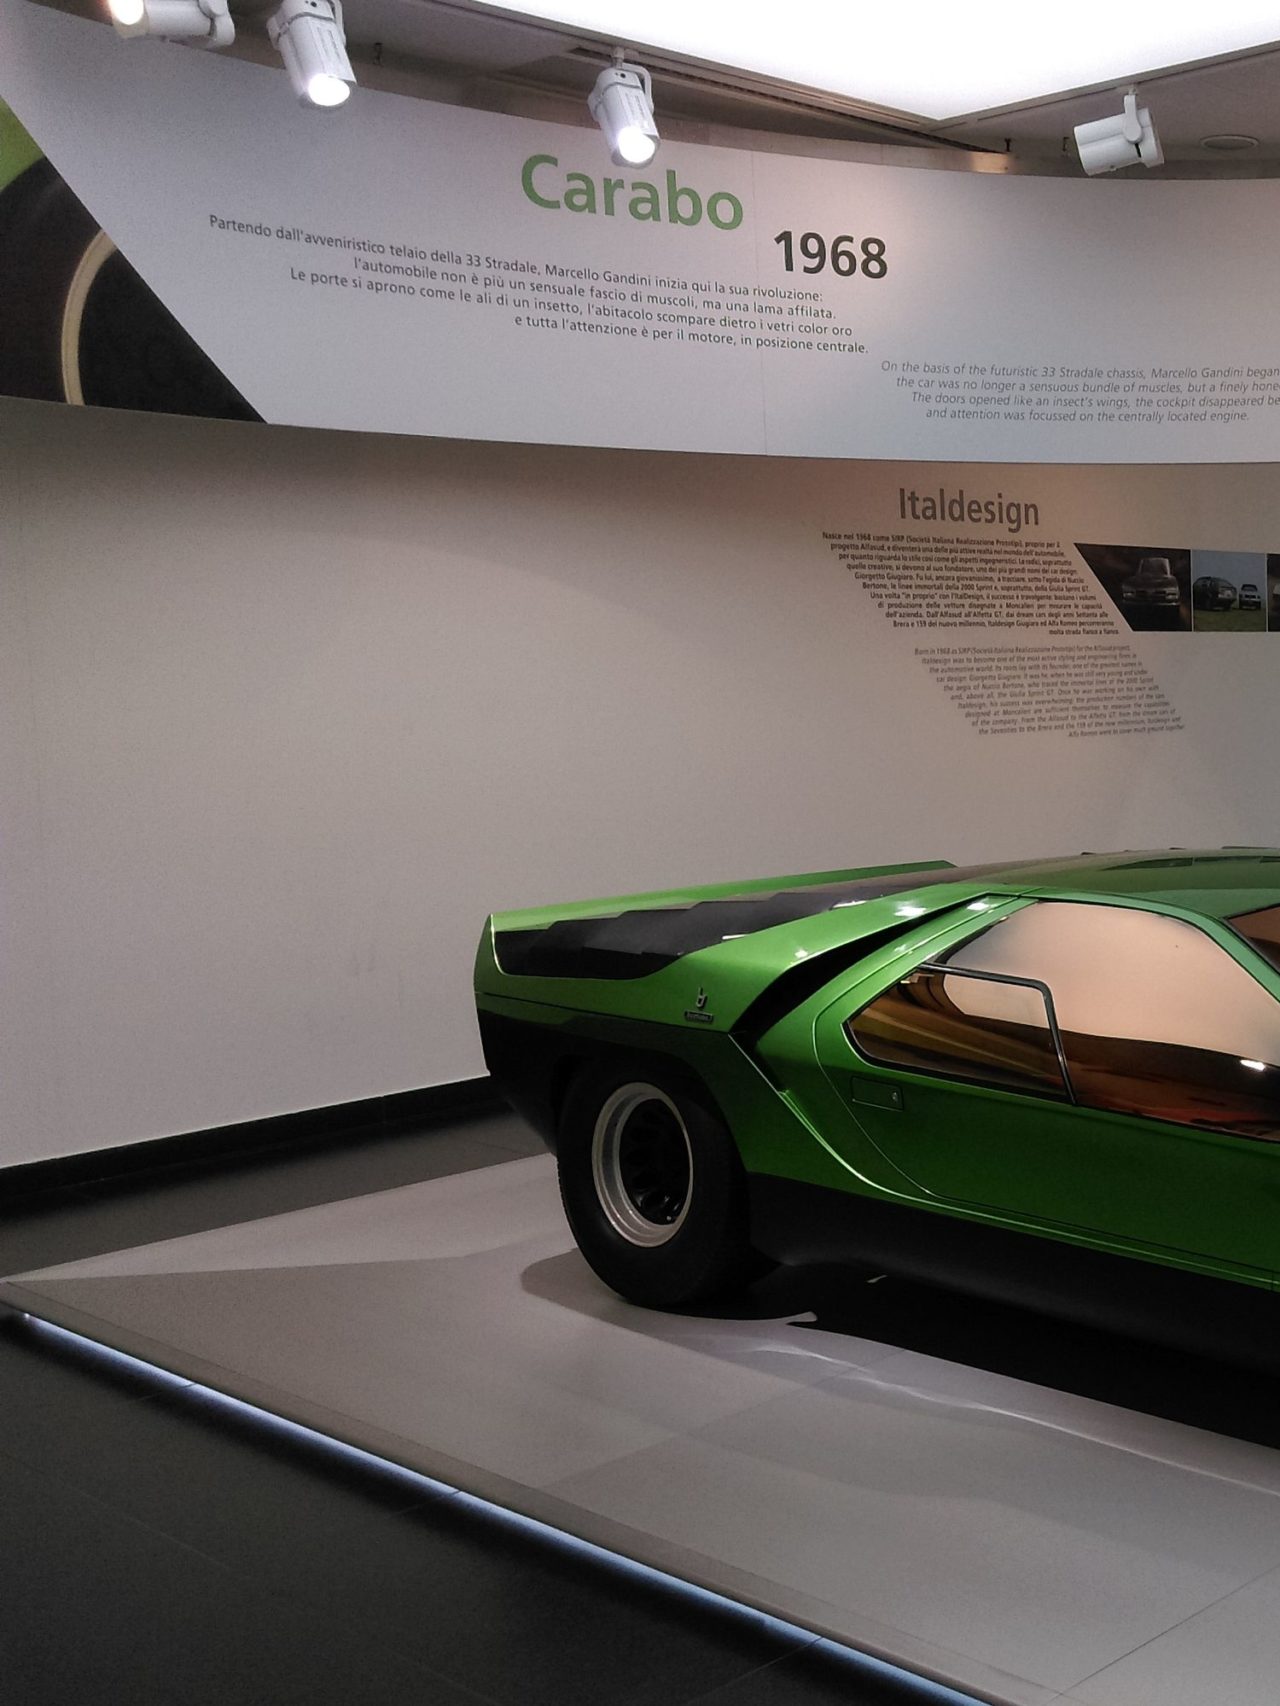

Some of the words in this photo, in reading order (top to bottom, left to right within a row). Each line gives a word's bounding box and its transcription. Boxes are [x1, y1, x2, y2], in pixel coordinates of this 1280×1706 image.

[521, 154, 744, 230] Carabo
[208, 213, 272, 237] Partendo
[274, 225, 385, 255] dall'avveniristico
[389, 244, 427, 261] telaio
[430, 249, 462, 265] della
[465, 253, 481, 267] 33
[484, 255, 540, 276] Stradale,
[544, 262, 600, 281] Marcello
[602, 269, 651, 287] Gandini
[655, 276, 687, 290] inizia
[691, 281, 711, 295] qui
[714, 281, 725, 294] la
[728, 284, 749, 295] sua
[752, 285, 822, 302] rivoluzione:
[774, 231, 888, 279] 1968
[290, 267, 306, 281] Le
[310, 273, 348, 288] porte
[351, 278, 362, 290] si
[366, 281, 415, 296] aprono
[419, 287, 455, 300] come
[459, 289, 471, 302] le
[476, 291, 491, 304] ali
[495, 293, 508, 306] di
[512, 297, 529, 309] un
[534, 298, 582, 316] insetto,
[587, 303, 653, 321] l'abitacolo
[656, 312, 715, 329] scompare
[719, 315, 756, 329] dietro
[759, 319, 763, 330] i
[766, 321, 794, 333] vetri
[797, 323, 827, 336] color
[831, 327, 852, 338] oro
[354, 256, 437, 280] l'automobile
[440, 271, 466, 284] non
[471, 273, 478, 286] è
[483, 276, 504, 291] più
[508, 280, 525, 291] un
[529, 283, 584, 298] sensuale
[589, 286, 626, 301] fascio
[630, 290, 642, 303] di
[646, 294, 697, 310] muscoli,
[702, 299, 721, 310] ma
[725, 301, 748, 313] una
[753, 301, 783, 316] lama
[787, 305, 835, 320] affilata.
[514, 316, 522, 326] e
[526, 316, 558, 330] tutta
[561, 318, 637, 337] l'attenzione
[641, 325, 648, 338] è
[652, 329, 672, 343] per
[676, 329, 684, 341] il
[687, 332, 736, 347] motore,
[740, 335, 752, 347] in
[755, 338, 813, 351] posizione
[816, 341, 868, 355] centrale.
[881, 359, 897, 371] On
[901, 361, 919, 372] the
[923, 362, 949, 374] basis
[953, 363, 964, 375] of
[968, 364, 986, 375] the
[990, 364, 1036, 376] futuristic
[1042, 365, 1055, 377] 33
[1059, 366, 1103, 378] Stradale
[1151, 367, 1197, 378] Marcello
[1201, 367, 1242, 378] Gandini
[1246, 366, 1279, 380] began
[896, 376, 914, 387] the
[917, 379, 934, 388] car
[937, 380, 960, 389] was
[963, 381, 977, 390] no
[980, 379, 1015, 394] longer
[1019, 383, 1025, 392] a
[1029, 384, 1078, 392] sensuous
[1082, 381, 1120, 392] bundle
[1123, 382, 1134, 393] of
[1187, 382, 1205, 393] but
[1209, 384, 1215, 393] a
[1219, 380, 1248, 395] finely
[912, 391, 931, 403] The
[934, 392, 965, 404] doors
[968, 395, 1010, 409] opened
[1013, 395, 1032, 406] like
[1035, 398, 1049, 406] an
[1052, 396, 1093, 407] insect's
[1134, 397, 1153, 408] the
[1156, 397, 1195, 411] cockpit
[1198, 394, 1264, 410] disappeared
[926, 407, 946, 418] and
[950, 408, 1000, 419] attention
[1004, 411, 1024, 420] was
[1029, 409, 1075, 421] focussed
[1079, 413, 1093, 422] on
[1097, 411, 1114, 422] the
[1118, 411, 1163, 425] centrally
[1167, 410, 1206, 422] located
[900, 488, 1038, 533] Italdesign
